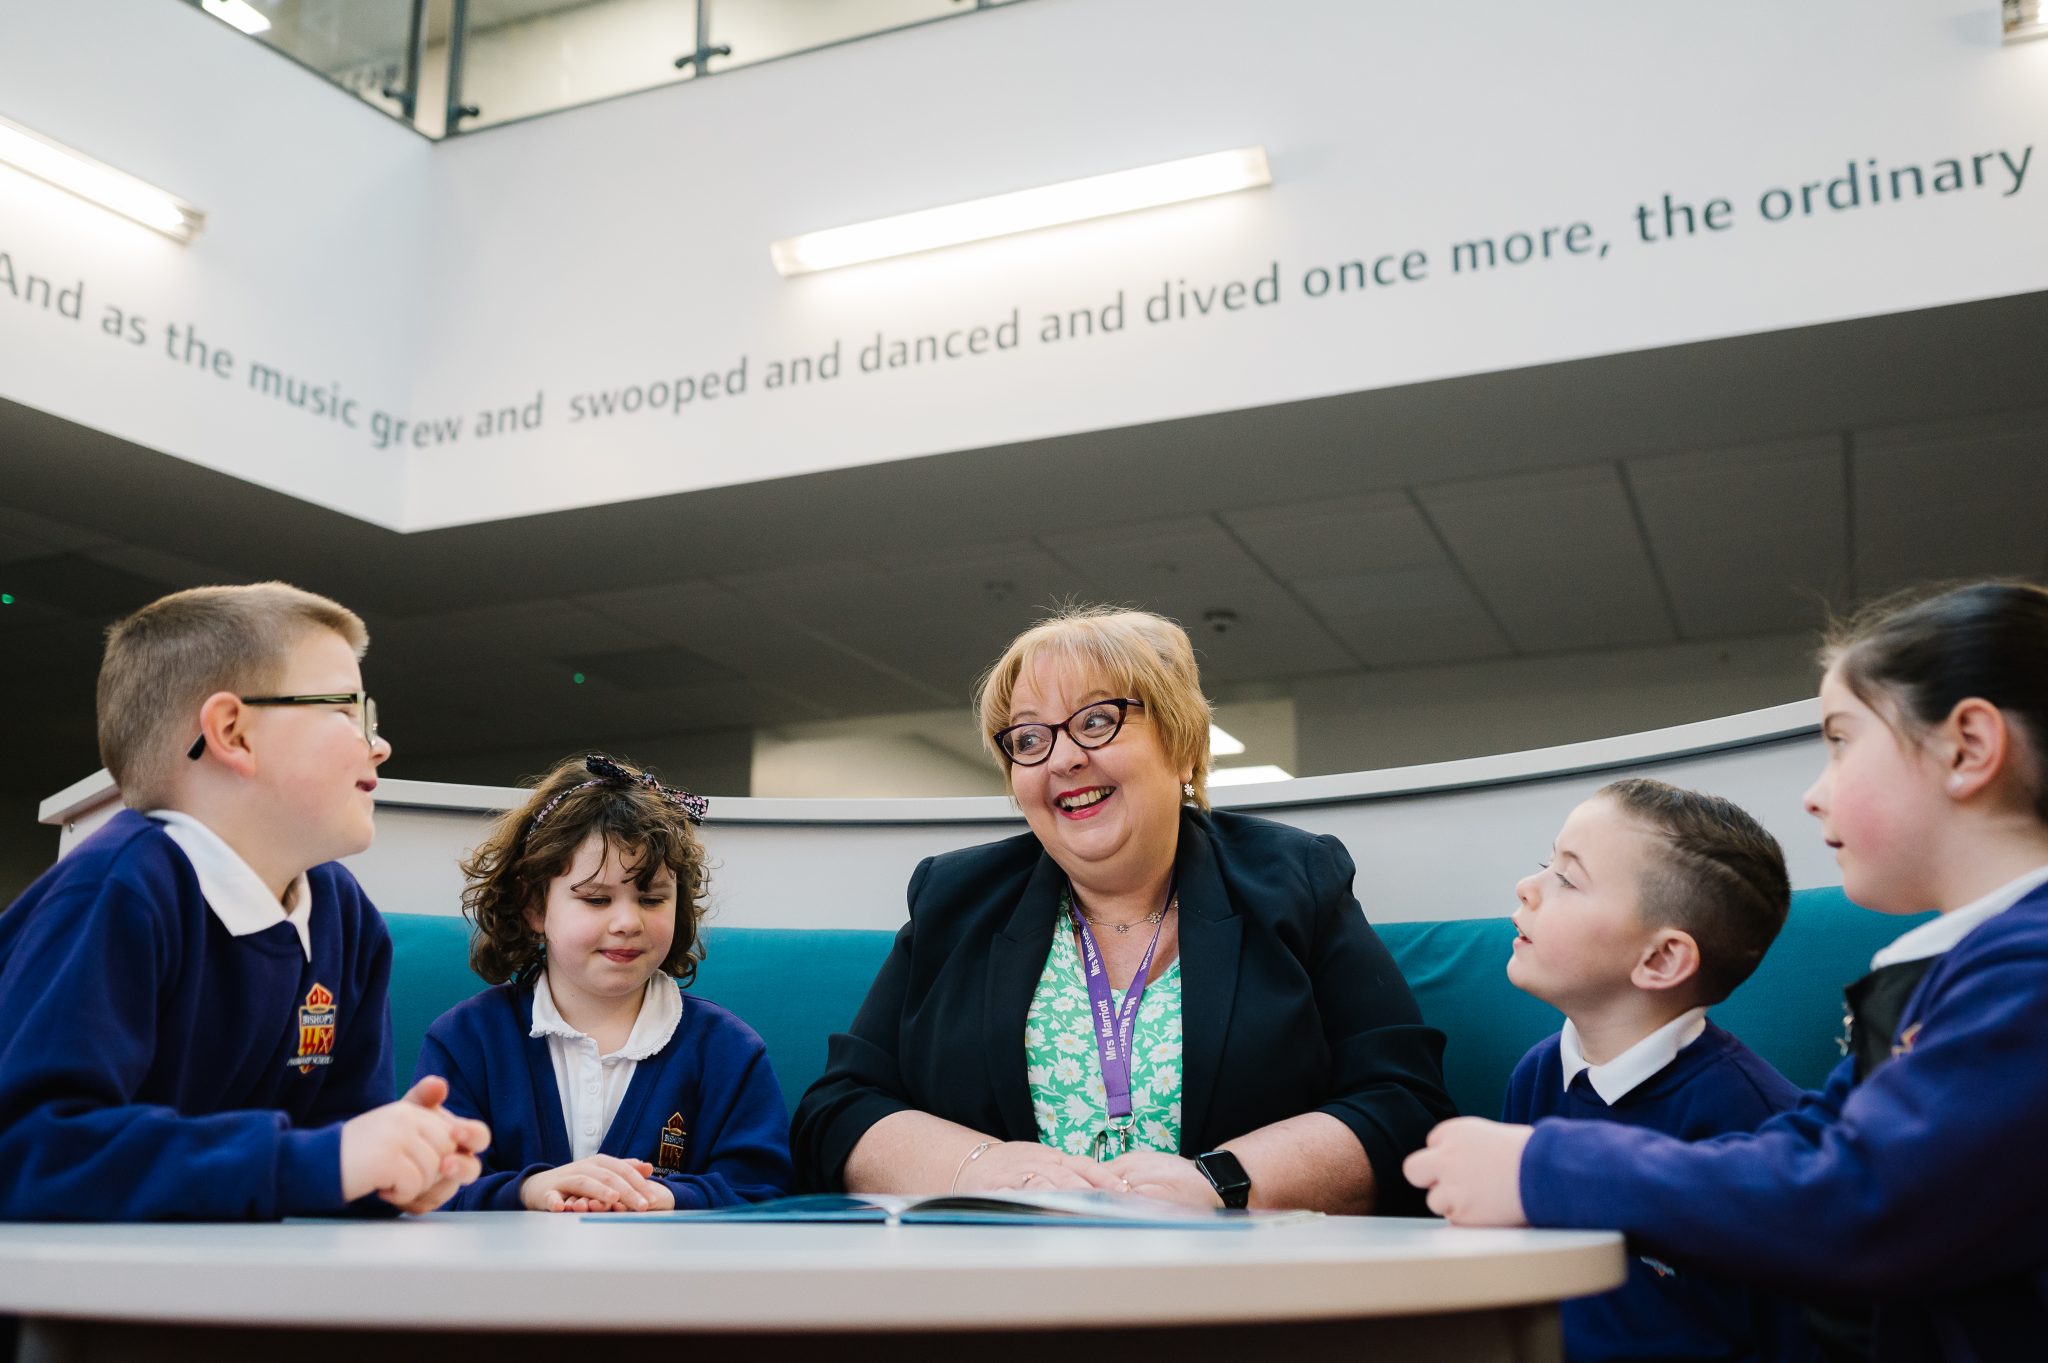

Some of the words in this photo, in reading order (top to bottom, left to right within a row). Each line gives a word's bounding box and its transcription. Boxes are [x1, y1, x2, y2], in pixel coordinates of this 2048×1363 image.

[0, 250, 85, 321] And
[101, 305, 148, 347] as
[165, 322, 235, 380] the
[249, 363, 357, 429] music
[370, 411, 462, 451] grew
[474, 391, 545, 438] and
[568, 355, 748, 422] swooped
[764, 339, 842, 390] and
[857, 307, 1020, 375] danced
[1035, 289, 1126, 345] and
[1144, 260, 1282, 326] dived
[1301, 249, 1429, 298] once
[1451, 221, 1612, 275] more,
[1632, 192, 1736, 246] the
[1756, 144, 2036, 223] ordinary
[1091, 958, 1101, 977] Mrs
[1124, 996, 1137, 1017] Mrs
[1098, 999, 1114, 1038] Marriott
[1105, 1039, 1117, 1061] Mrs
